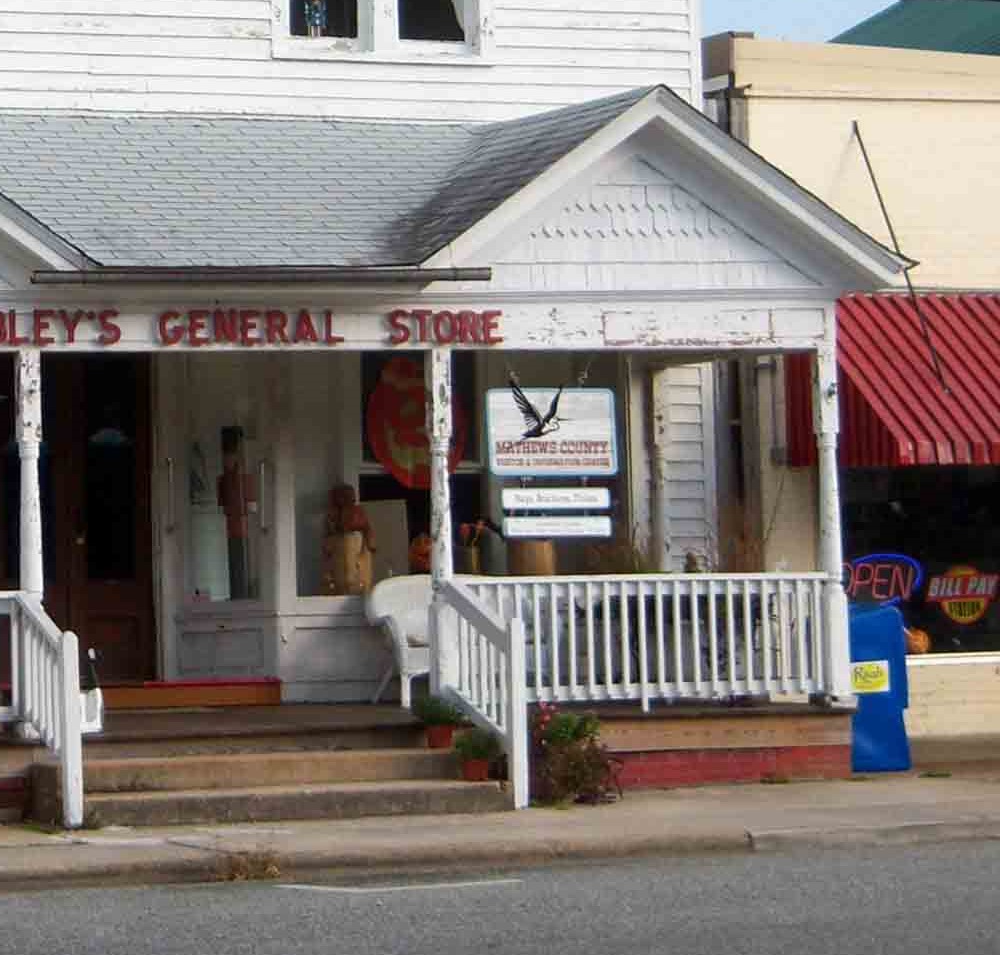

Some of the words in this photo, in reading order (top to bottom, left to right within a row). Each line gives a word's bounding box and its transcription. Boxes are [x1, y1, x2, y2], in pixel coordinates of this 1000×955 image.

[158, 308, 345, 346] GENERAL
[389, 308, 504, 346] STORE
[495, 440, 557, 455] MATHEWS
[559, 440, 609, 455] COUNTY
[928, 576, 961, 597] BILL
[966, 573, 999, 596] PAY
